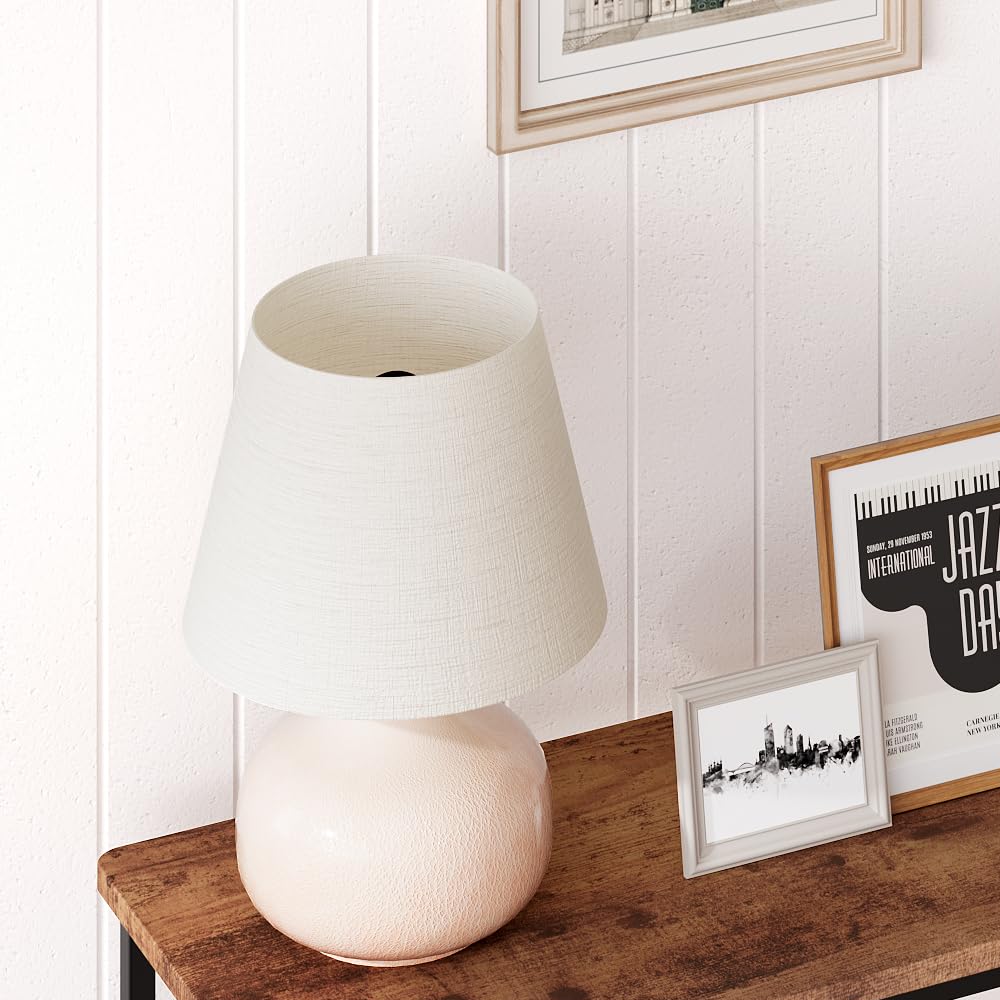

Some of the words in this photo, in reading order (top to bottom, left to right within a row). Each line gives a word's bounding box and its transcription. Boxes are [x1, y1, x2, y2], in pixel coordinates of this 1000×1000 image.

[866, 542, 887, 554] SUNDAY,
[894, 533, 921, 547] NOVEMBER
[921, 530, 933, 541] 1953
[867, 544, 936, 580] INTERNATIONAL
[891, 713, 918, 727] FITZGERALD
[966, 713, 999, 726] CARNEGIE
[895, 721, 923, 735] ARMSTRONG
[967, 727, 981, 736] NEW
[983, 722, 1000, 732] YORK
[894, 732, 919, 745] ELLINGTON
[898, 741, 921, 754] VAUGHAN
